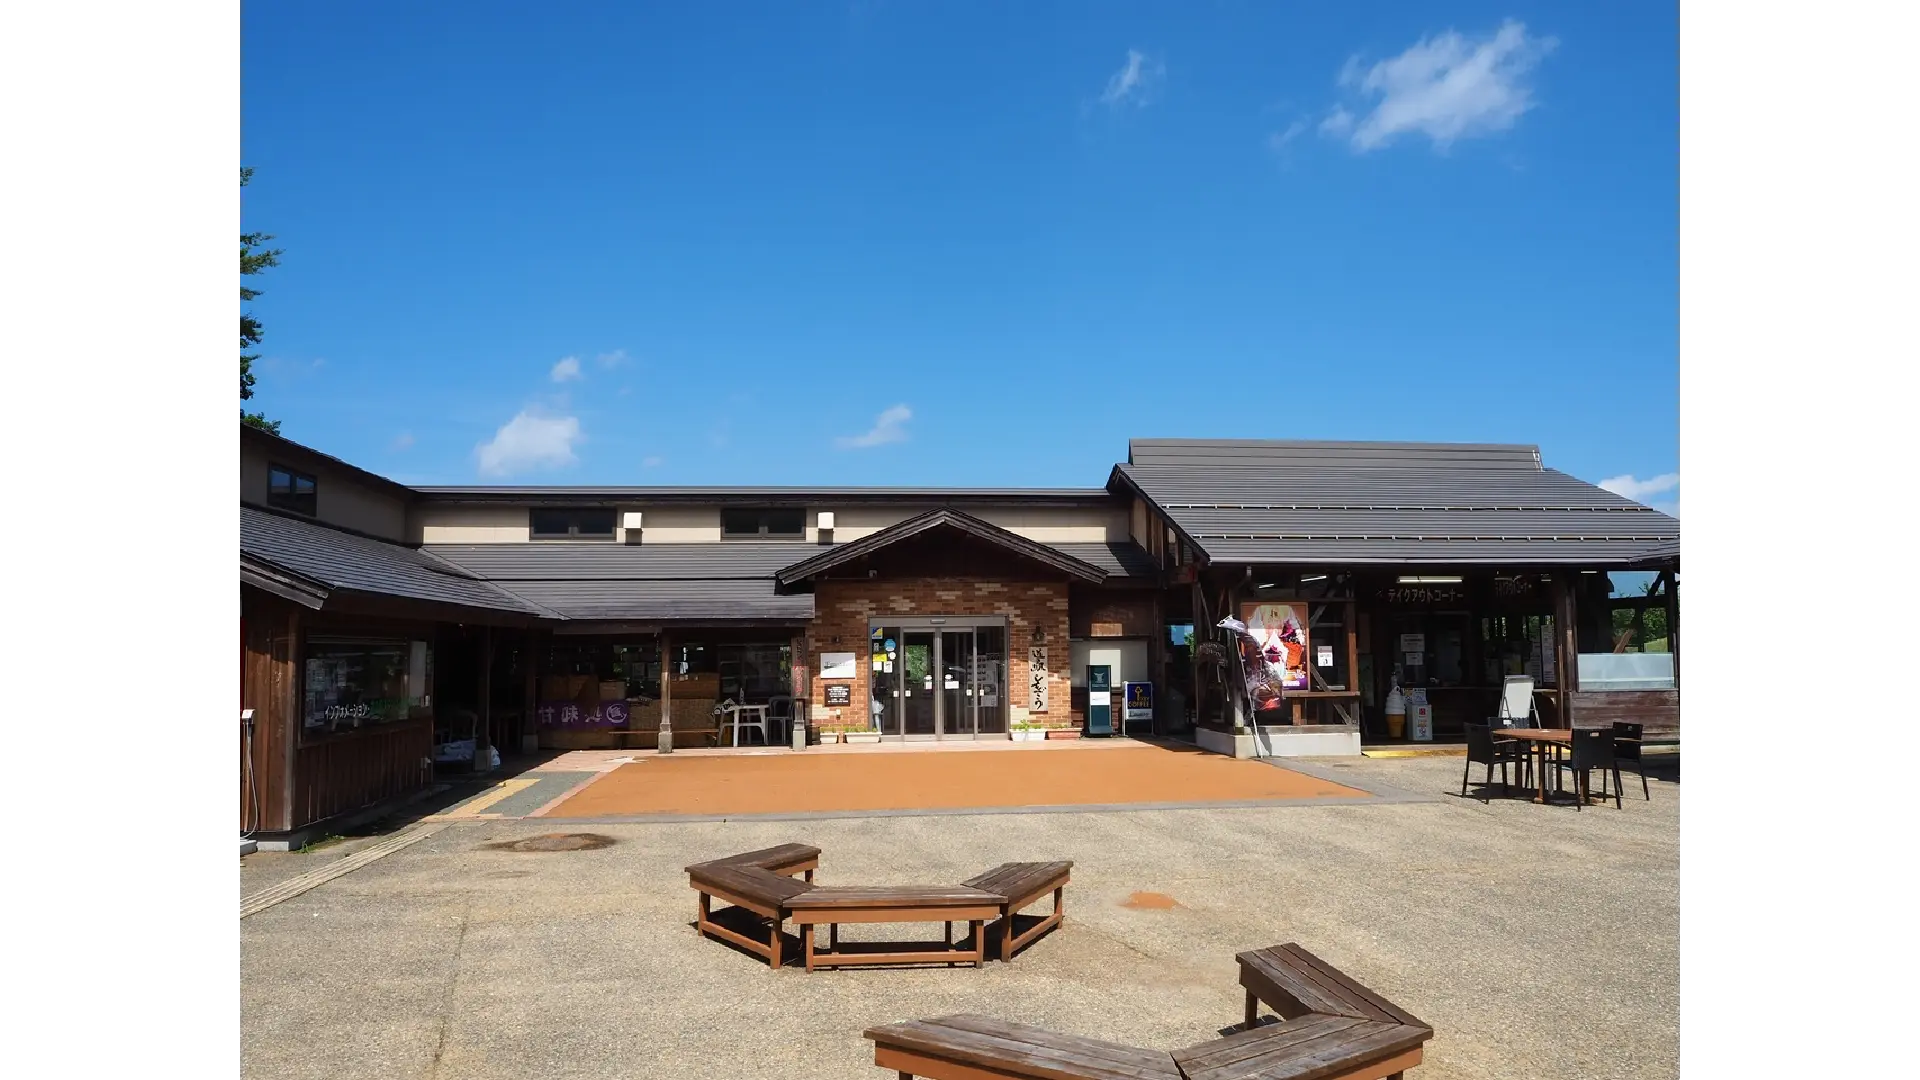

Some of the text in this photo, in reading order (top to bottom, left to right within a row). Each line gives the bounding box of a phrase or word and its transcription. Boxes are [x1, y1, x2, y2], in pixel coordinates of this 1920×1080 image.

[1387, 588, 1463, 603] テイクアウトコーナー
